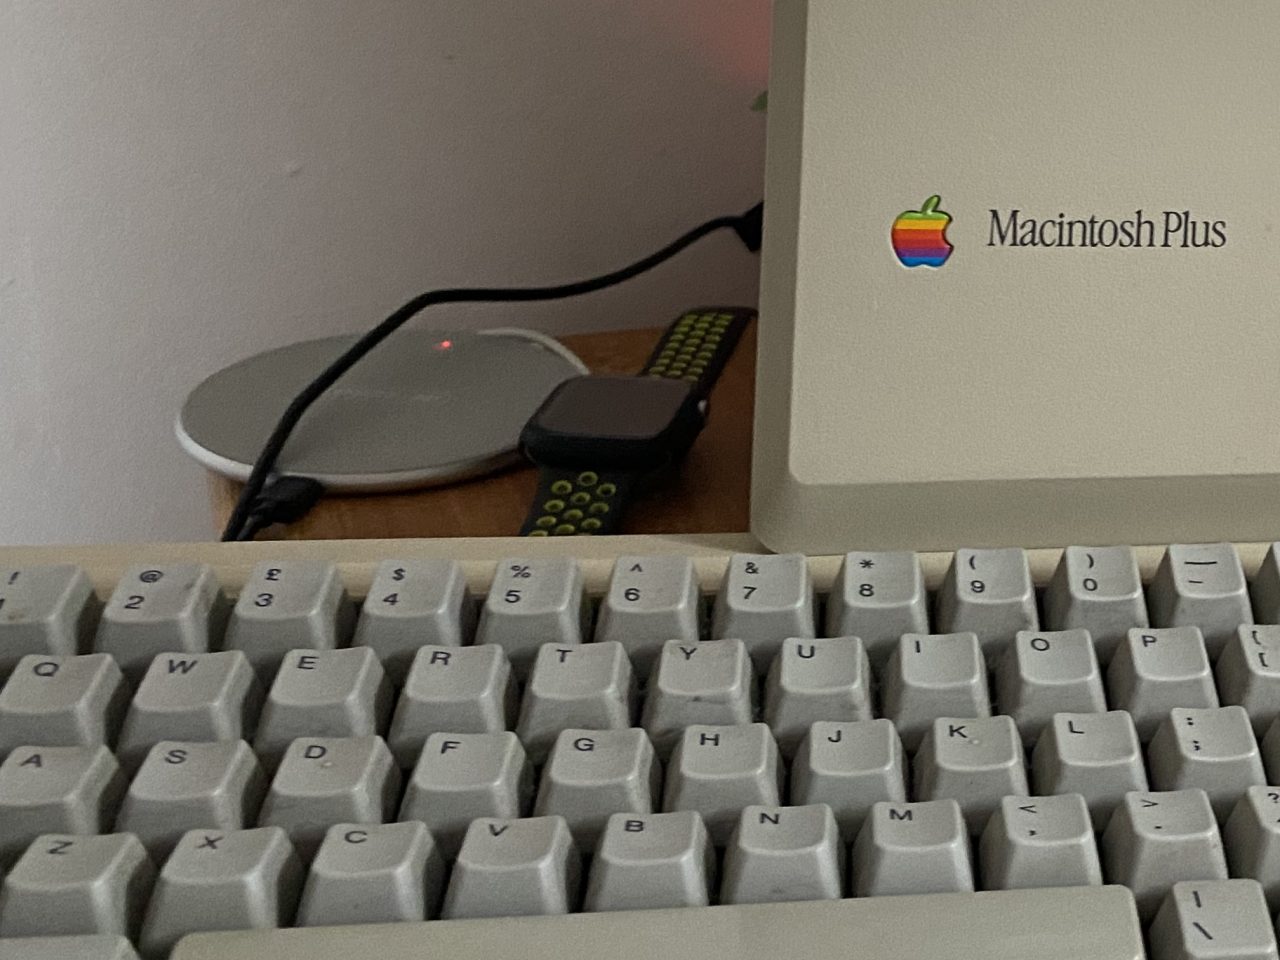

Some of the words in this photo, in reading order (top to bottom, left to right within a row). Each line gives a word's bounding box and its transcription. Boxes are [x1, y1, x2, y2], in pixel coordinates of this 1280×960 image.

[986, 208, 1156, 248] Macintosh
[1161, 210, 1227, 248] Plus
[859, 583, 874, 597] 8
[970, 580, 985, 594] 9
[1083, 578, 1098, 592] 0
[254, 593, 273, 607] 3
[383, 593, 399, 606] 4
[504, 590, 521, 604] 5
[624, 588, 640, 602] 6
[743, 586, 757, 600] 7
[125, 595, 145, 609] 2
[1030, 638, 1050, 652] O
[1142, 635, 1157, 647] P
[556, 649, 572, 663] T
[679, 646, 697, 660] Y
[797, 644, 815, 659] U
[297, 656, 319, 670] E
[430, 652, 451, 666] R
[33, 662, 59, 677] Q
[168, 659, 198, 674] W
[949, 725, 968, 739] K
[1068, 721, 1085, 734] L
[699, 733, 720, 746] H
[828, 730, 842, 743] J
[304, 745, 326, 759] D
[440, 741, 461, 754] F
[574, 738, 594, 752] G
[20, 754, 42, 768] A
[164, 749, 188, 764] S
[760, 812, 780, 825] N
[889, 808, 913, 820] M
[489, 824, 508, 837] V
[624, 820, 644, 832] B
[198, 835, 223, 849] X
[344, 830, 368, 844] C
[46, 841, 73, 855] Z
